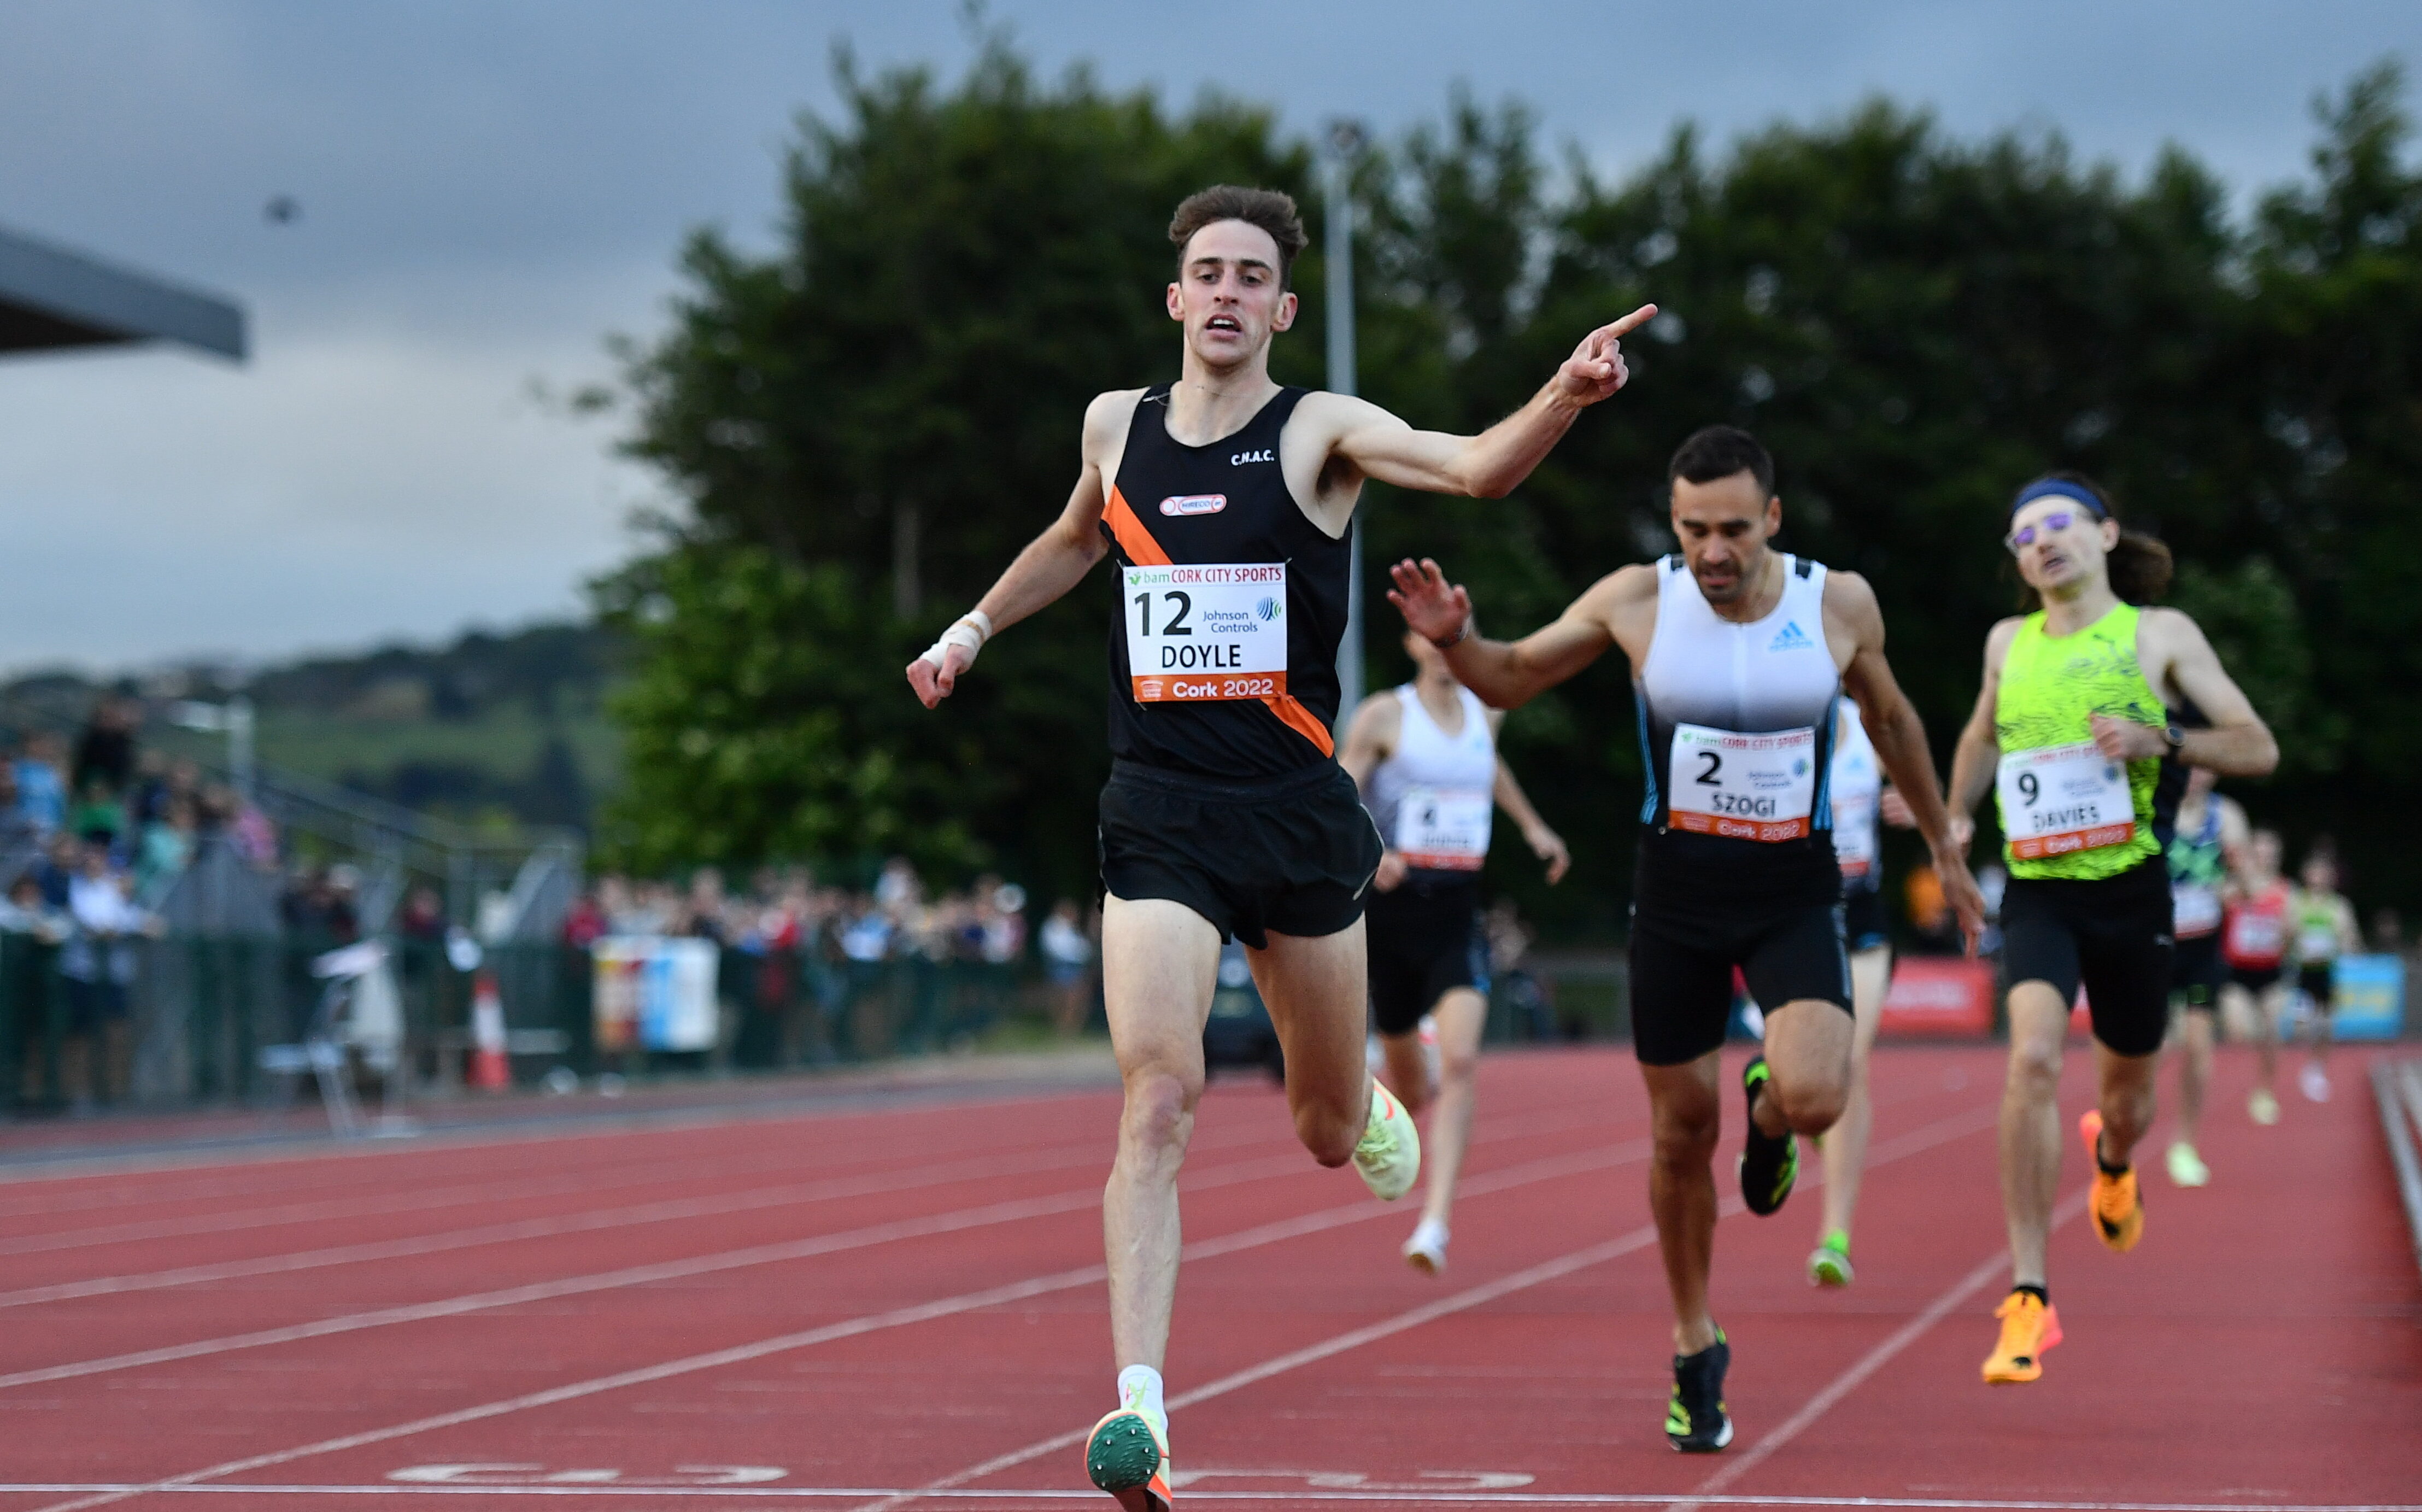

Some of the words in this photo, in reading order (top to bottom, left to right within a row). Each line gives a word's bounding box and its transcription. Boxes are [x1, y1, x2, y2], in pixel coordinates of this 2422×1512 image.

[1144, 571, 1170, 583] bam
[1172, 570, 1202, 583] CORK
[1205, 569, 1231, 582] CITY
[1235, 567, 1282, 582] SPORTS
[1134, 591, 1192, 636] 12
[1203, 610, 1248, 622] Johnson
[1211, 622, 1258, 633] Controls
[1162, 644, 1241, 668] DOYLE
[1172, 681, 1218, 698] Cork
[1223, 678, 1274, 696] 2022
[1696, 752, 1722, 786] 2
[2018, 772, 2040, 806] 9
[1713, 793, 1775, 816] SZOGI
[1717, 819, 1756, 839] Cork
[1761, 821, 1800, 841] 2022
